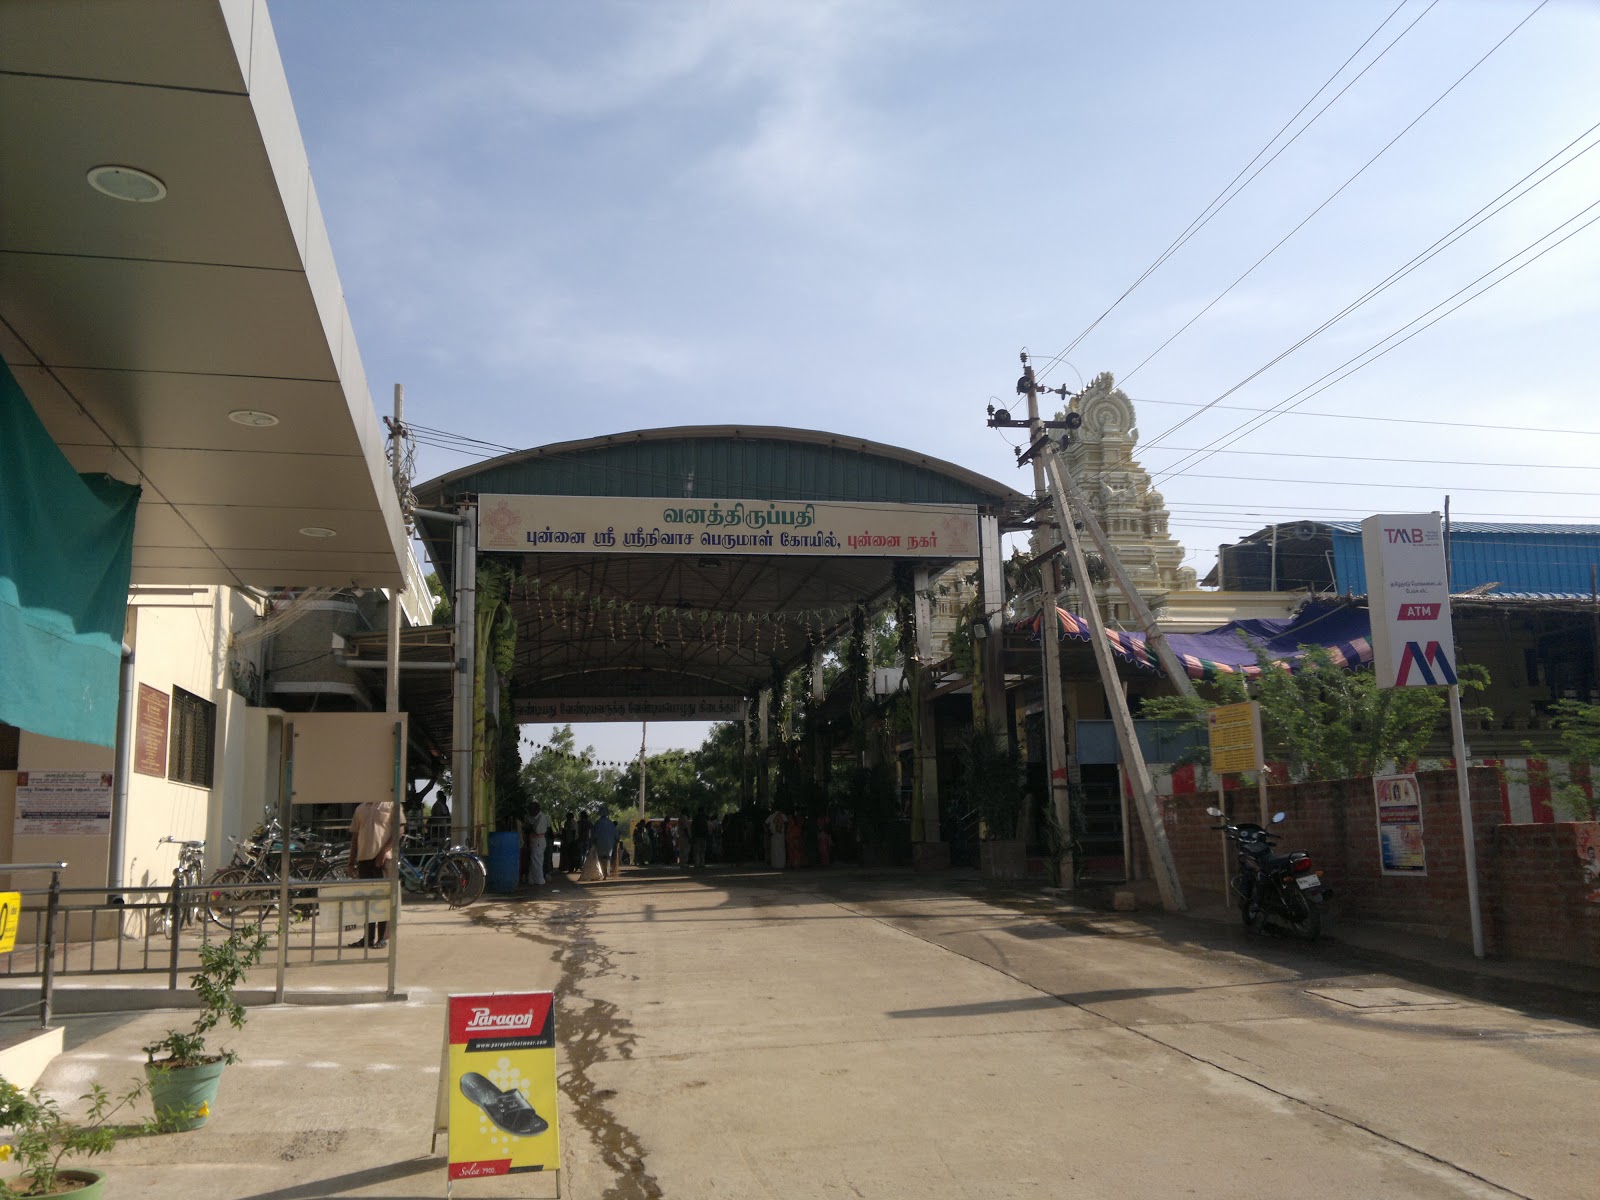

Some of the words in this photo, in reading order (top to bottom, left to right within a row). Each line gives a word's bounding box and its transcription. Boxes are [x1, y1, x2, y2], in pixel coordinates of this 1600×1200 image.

[663, 502, 815, 529] வனத்திருப்பதி
[527, 526, 586, 546] புன்னை
[700, 528, 773, 549] பெருமாள்
[779, 529, 841, 549] கோயில்,
[847, 531, 901, 549] புன்னை
[907, 531, 938, 550] நகர்
[1384, 529, 1423, 543] TMB
[1407, 606, 1432, 617] ATM
[466, 1008, 533, 1029] Paragon
